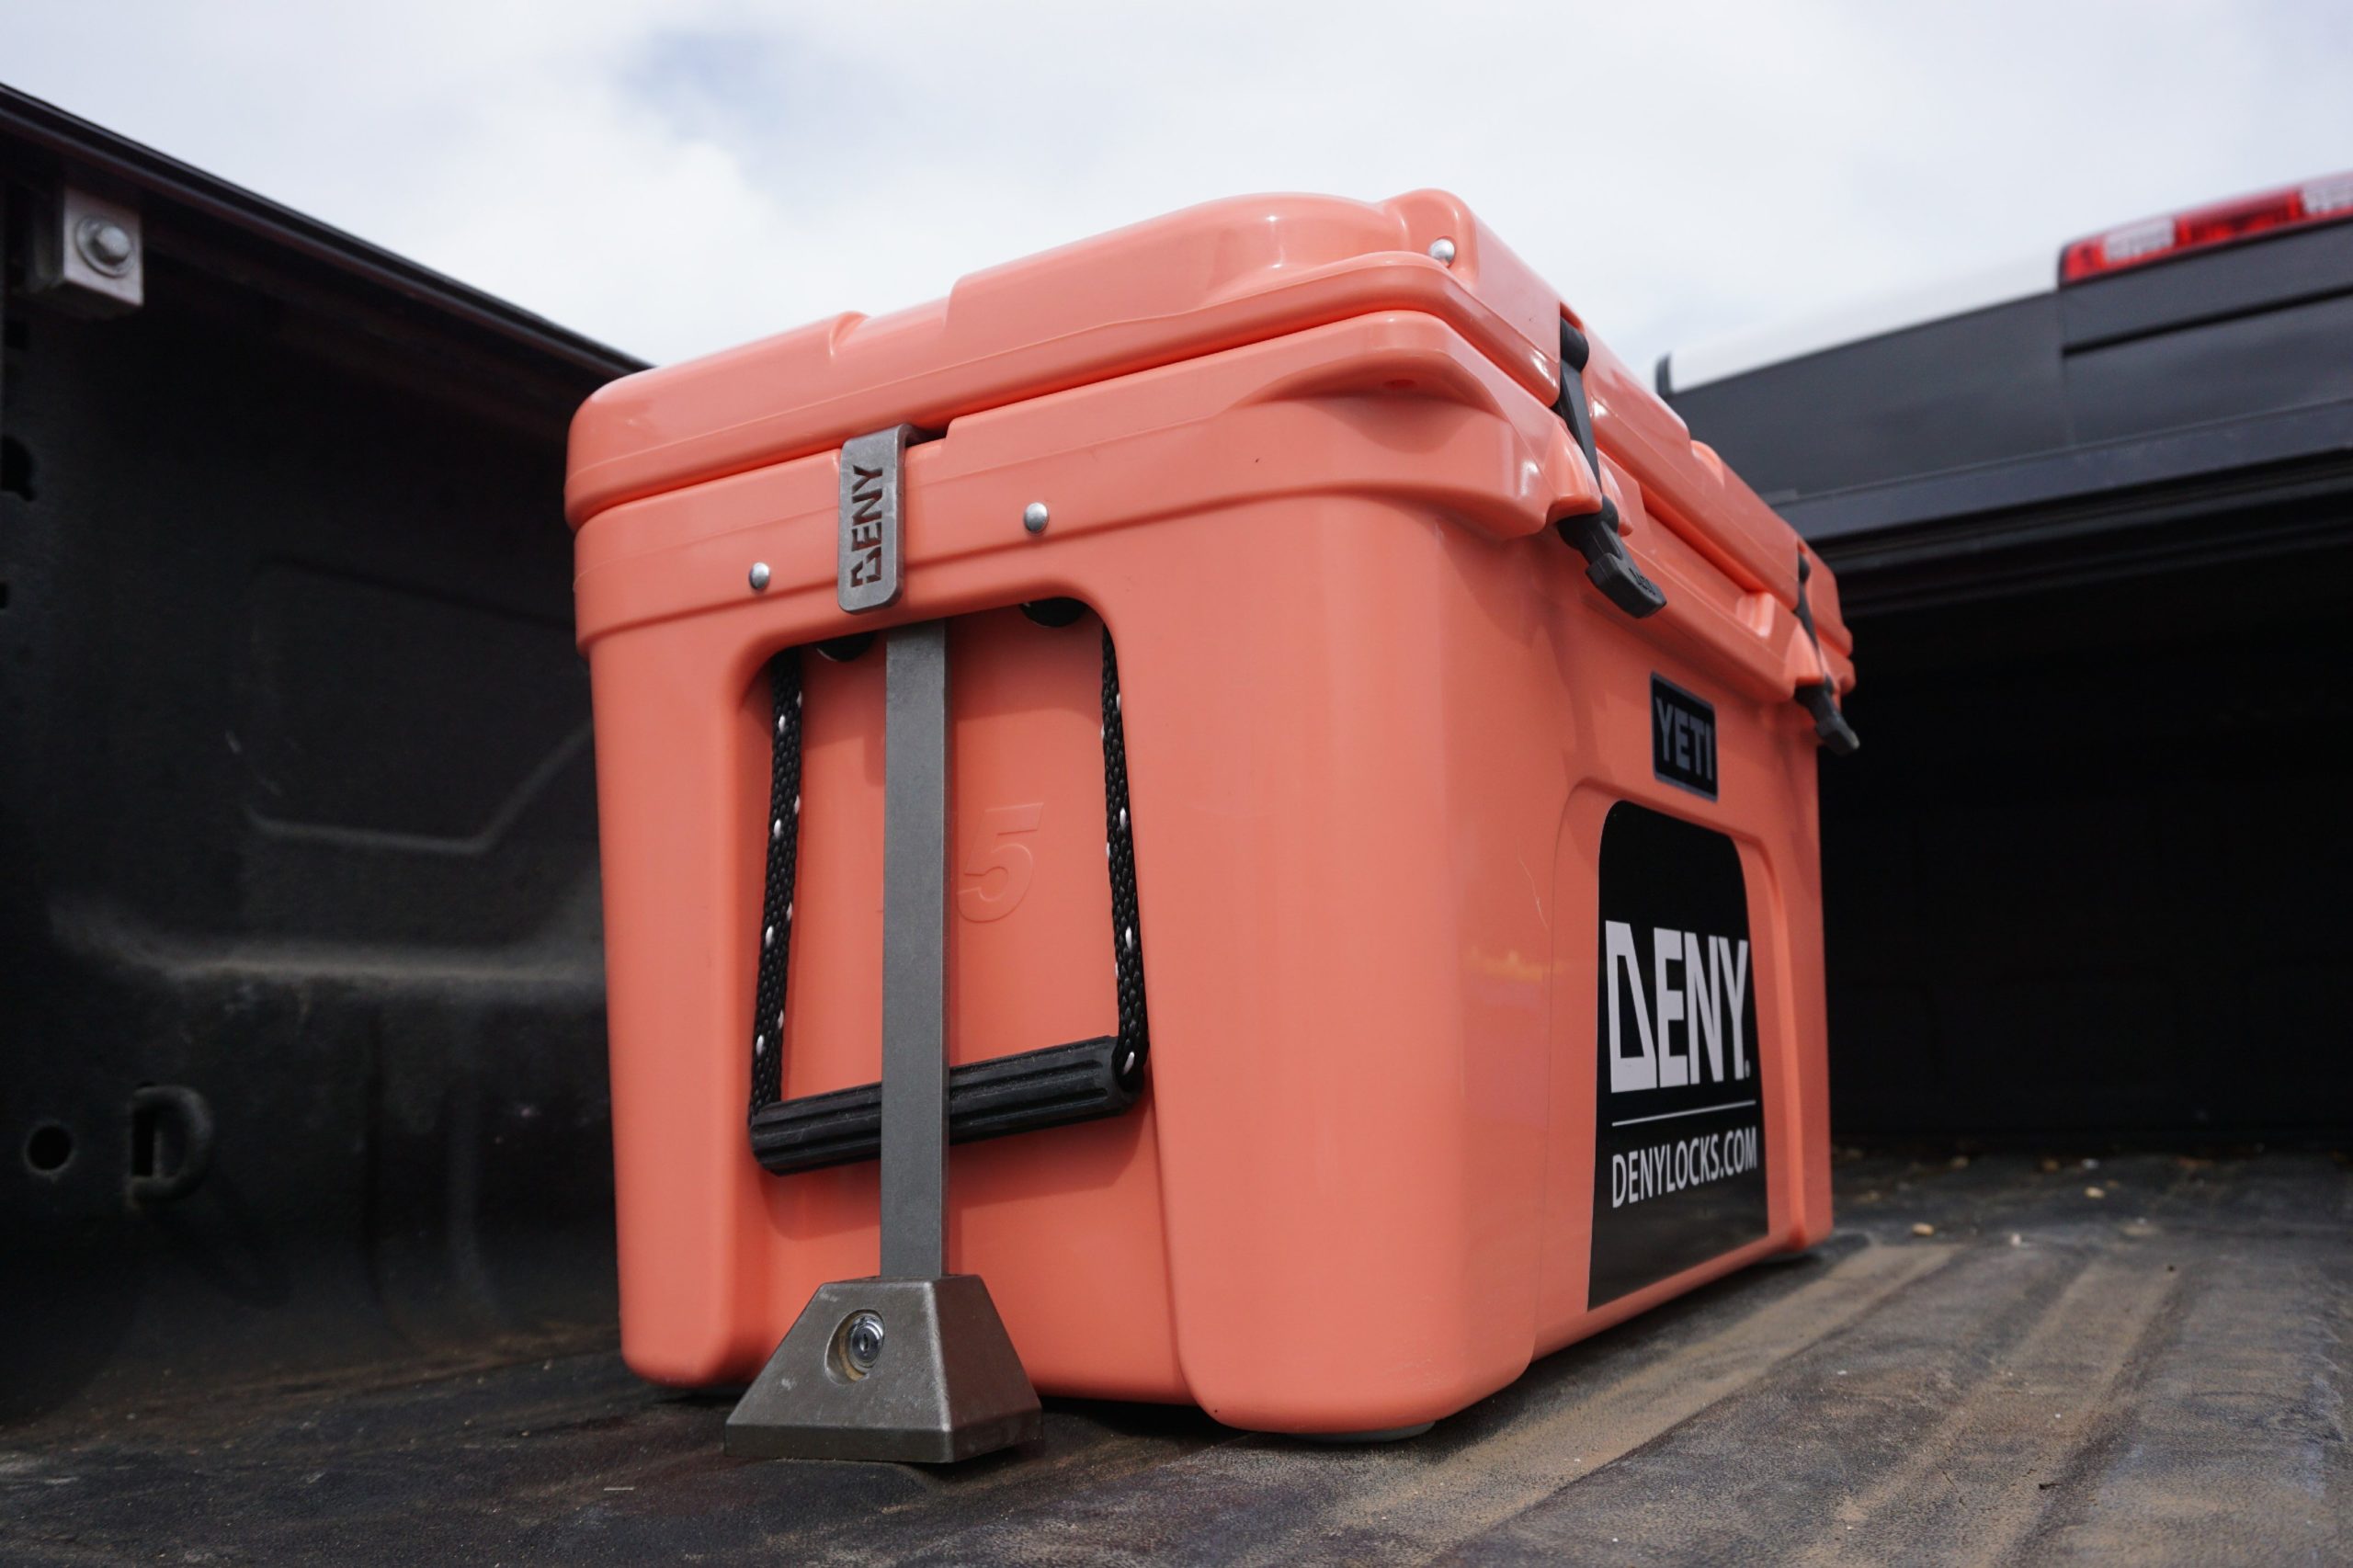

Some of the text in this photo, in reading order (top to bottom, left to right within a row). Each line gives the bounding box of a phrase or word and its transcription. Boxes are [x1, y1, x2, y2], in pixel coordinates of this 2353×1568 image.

[851, 465, 883, 587] DENY
[1655, 697, 1713, 781] YETI
[1605, 920, 1748, 1093] DENY
[1612, 1127, 1757, 1209] DENYLOCKS.COM
